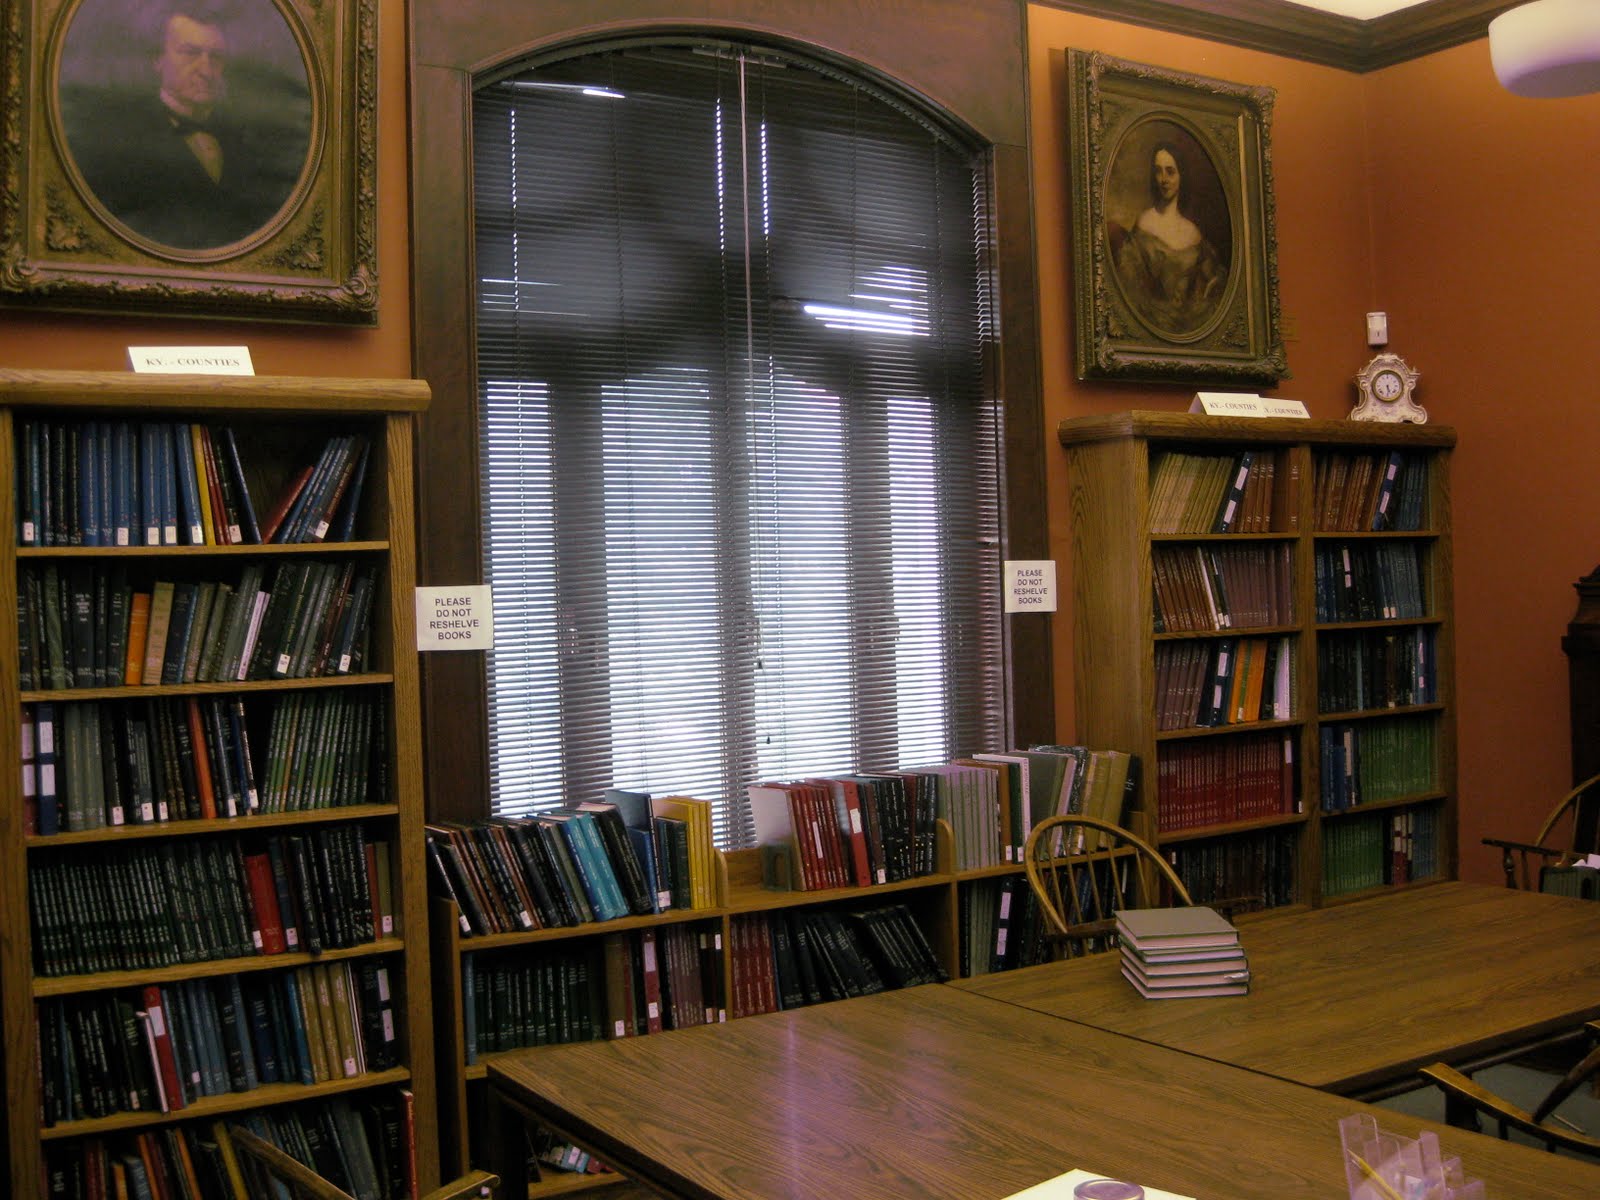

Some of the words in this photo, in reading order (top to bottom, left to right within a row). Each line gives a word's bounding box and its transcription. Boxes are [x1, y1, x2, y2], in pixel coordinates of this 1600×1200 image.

[177, 358, 240, 366] COUNTIES
[1017, 569, 1043, 577] PLEASE
[1013, 587, 1048, 595] RESHELVE
[435, 597, 472, 606] PLEASE
[436, 609, 450, 618] DO
[451, 608, 472, 617] NOT
[429, 619, 480, 629] RESHELVE
[437, 630, 472, 640] BOOKS
